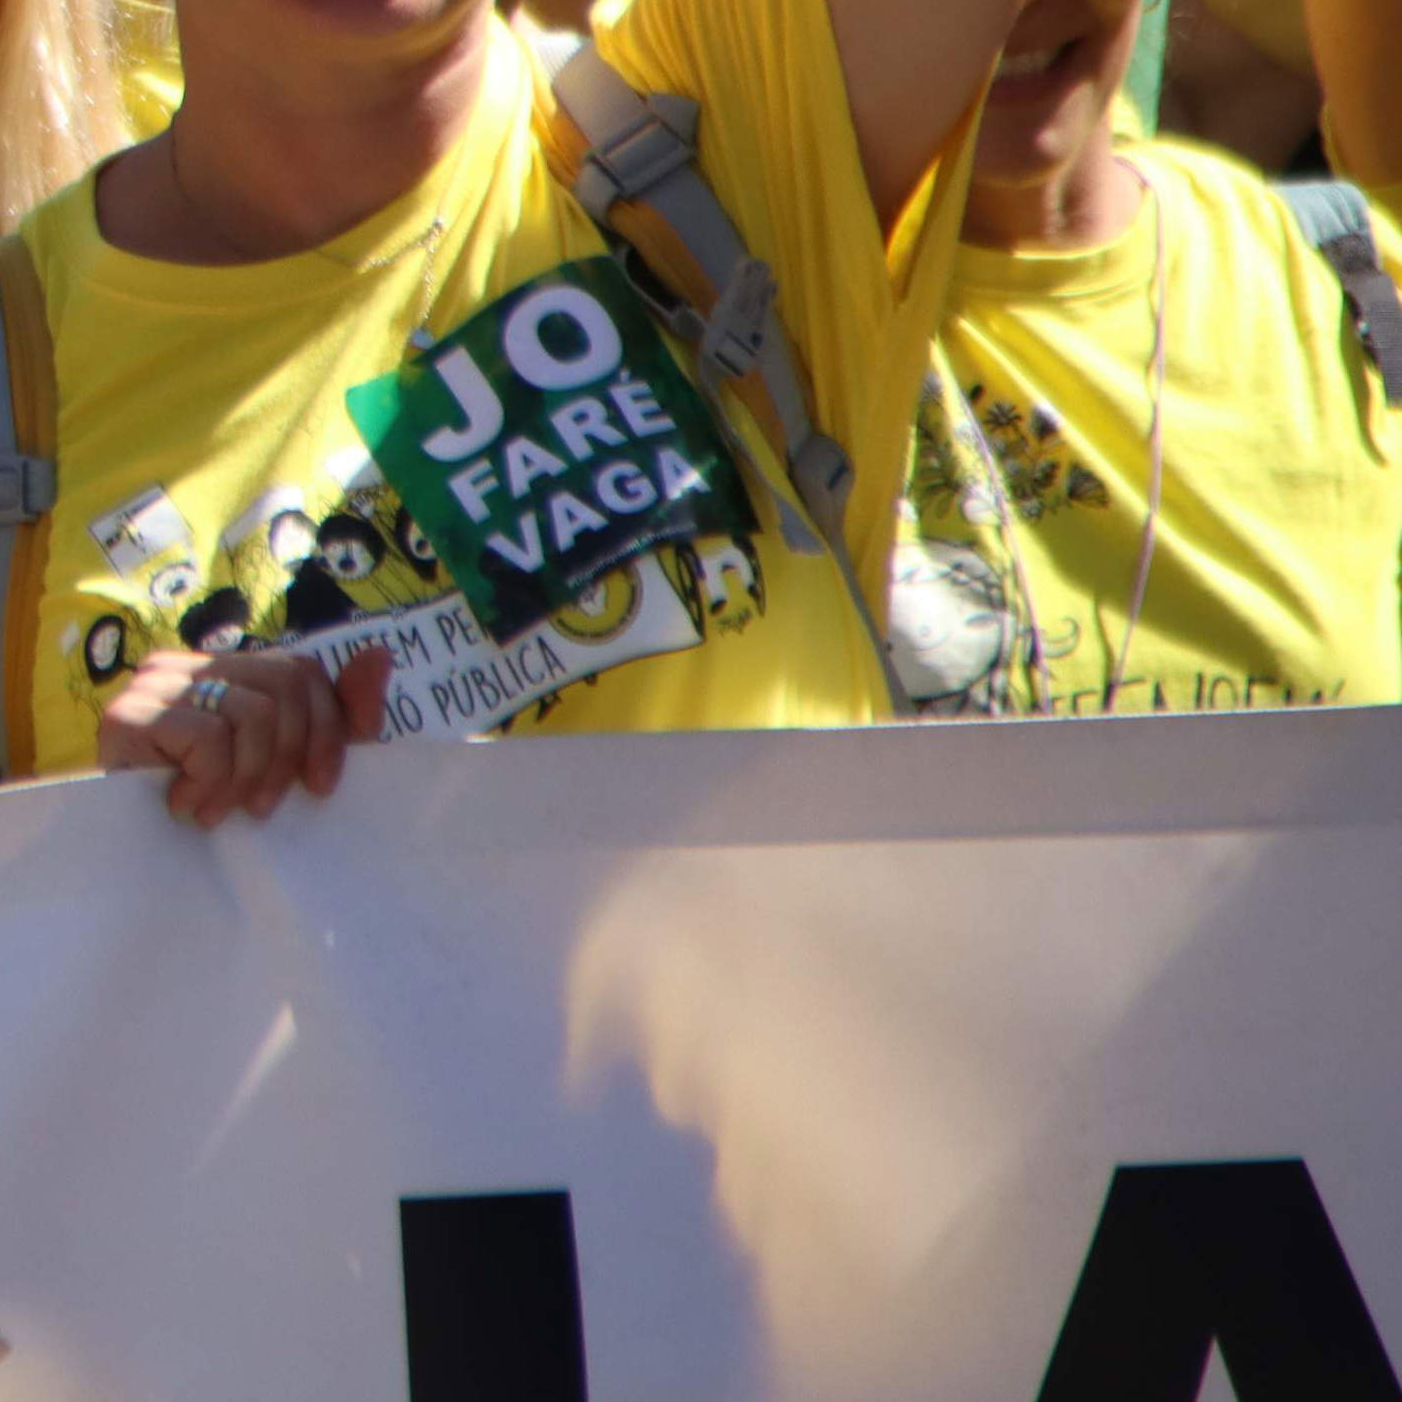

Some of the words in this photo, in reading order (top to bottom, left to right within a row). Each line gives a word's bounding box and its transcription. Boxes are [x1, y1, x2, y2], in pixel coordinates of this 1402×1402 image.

[421, 285, 623, 463] JO
[446, 369, 677, 524] FARÉ
[486, 448, 711, 574] VAGA
[430, 636, 567, 727] PÚBLICA
[435, 605, 491, 655] PE
